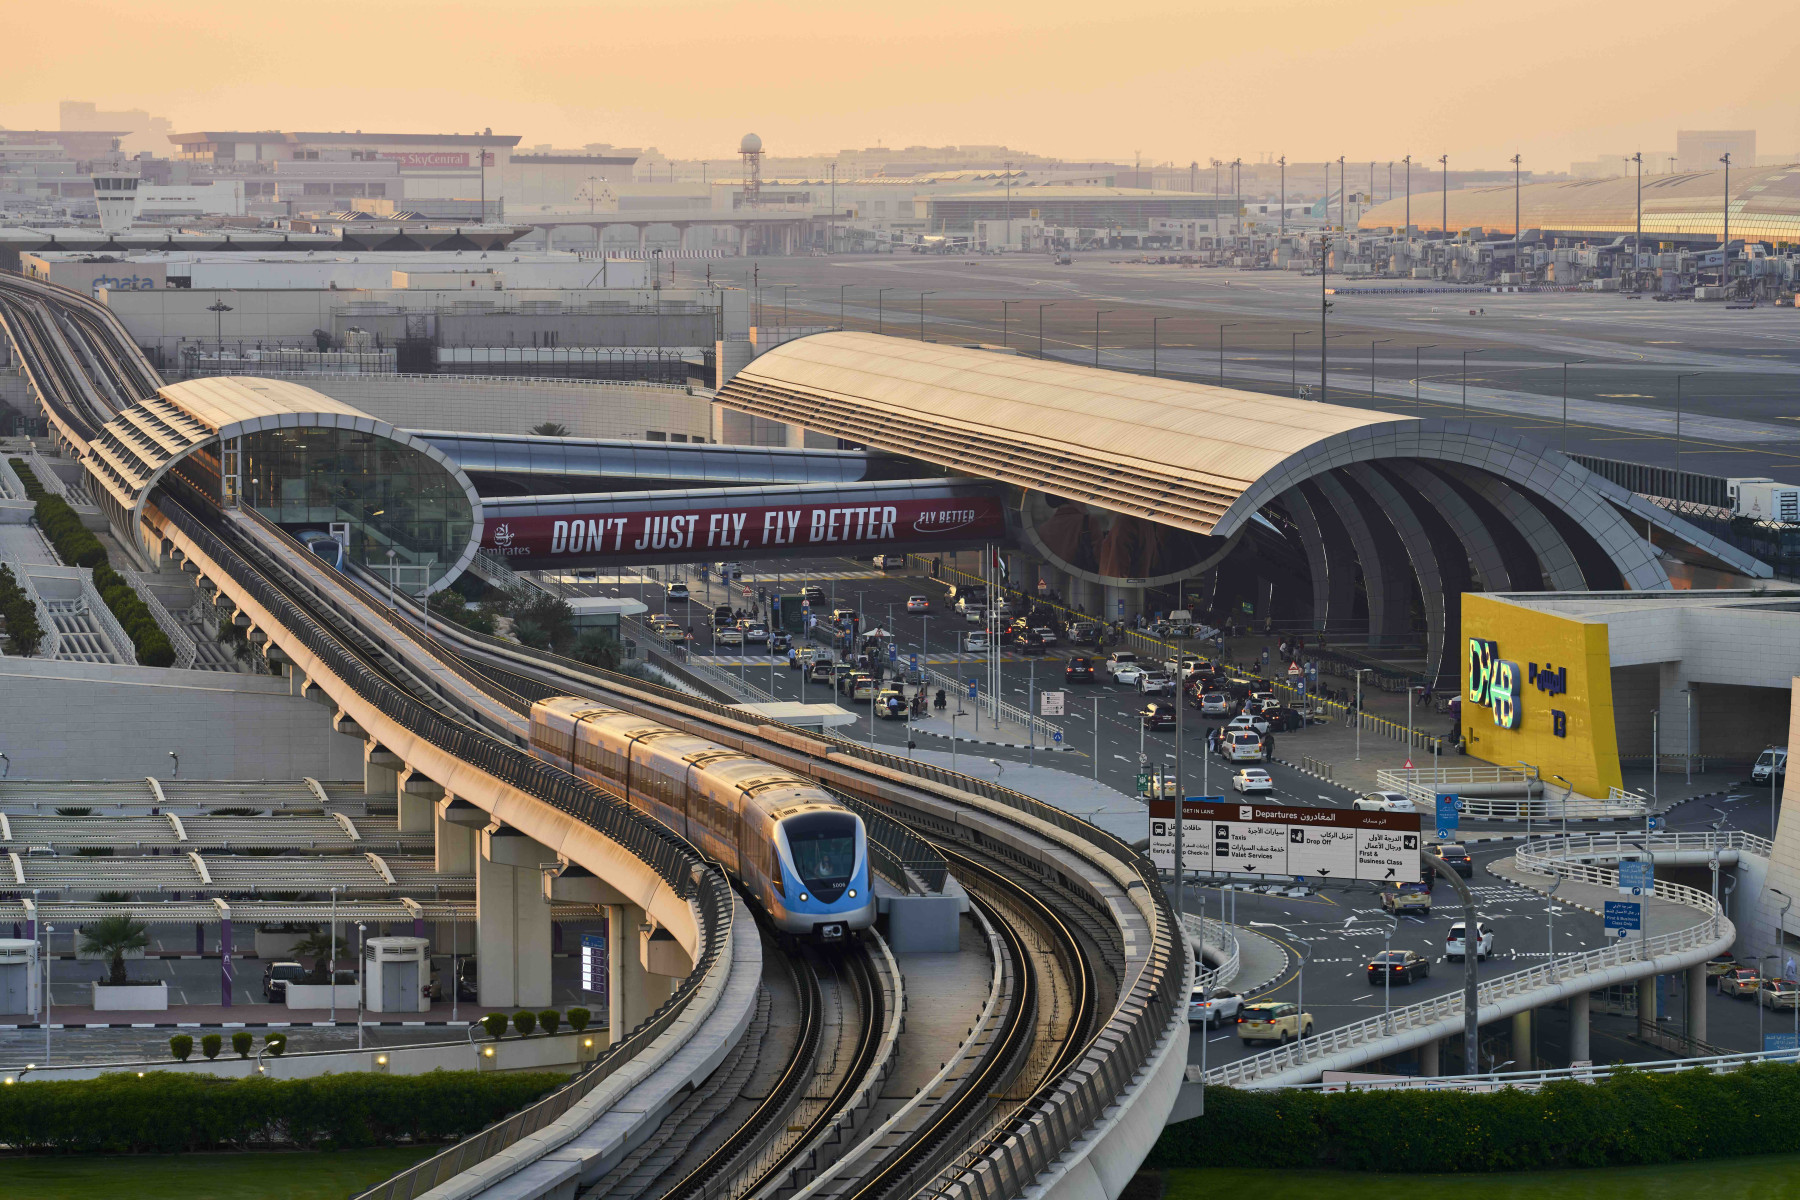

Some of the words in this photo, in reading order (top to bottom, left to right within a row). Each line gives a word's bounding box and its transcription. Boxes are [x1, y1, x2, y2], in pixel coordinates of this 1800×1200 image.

[408, 154, 463, 166] SkyCentral
[92, 274, 154, 288] dnata
[920, 512, 936, 524] FLY
[939, 510, 975, 523] BETTER
[551, 518, 628, 554] DON'T
[635, 515, 699, 550] JUST
[708, 513, 750, 548] FLY,
[762, 510, 802, 544] FLY
[809, 506, 897, 542] BETTER
[479, 546, 530, 556] Emirates
[1470, 638, 1519, 729] DXB
[1552, 709, 1566, 738] T3
[1255, 810, 1298, 820] Departures
[1300, 812, 1336, 822] المغادرون
